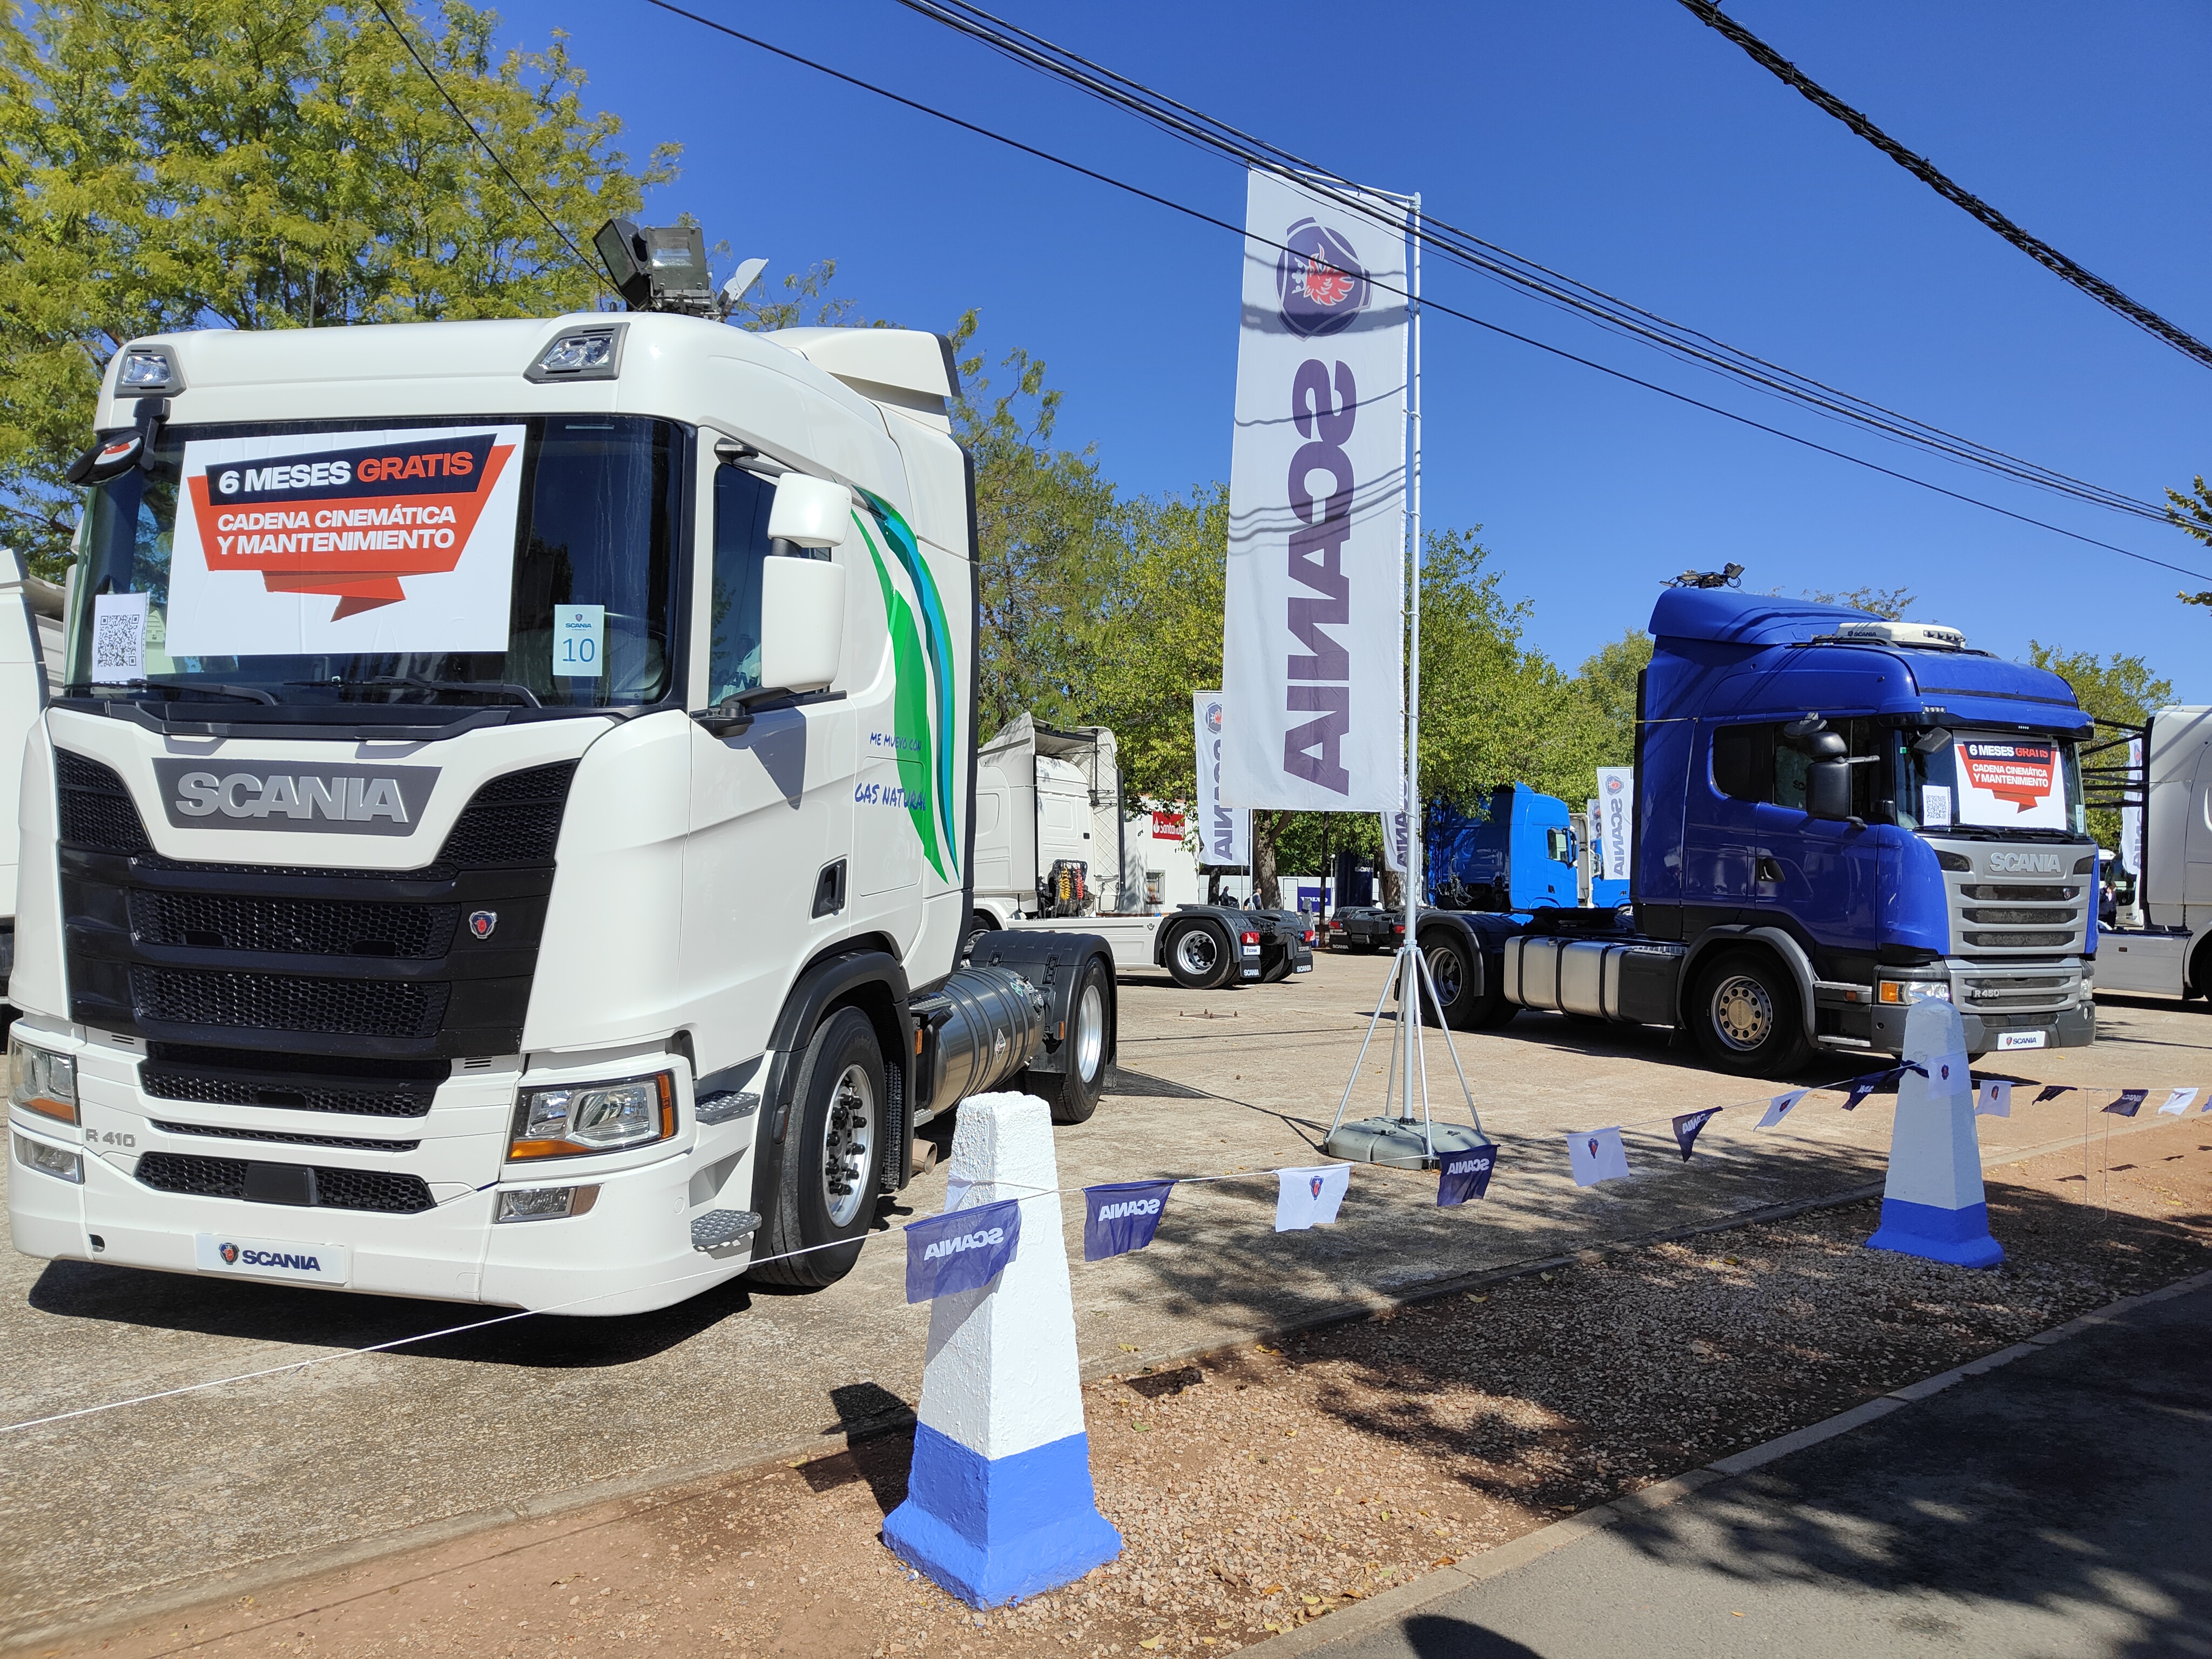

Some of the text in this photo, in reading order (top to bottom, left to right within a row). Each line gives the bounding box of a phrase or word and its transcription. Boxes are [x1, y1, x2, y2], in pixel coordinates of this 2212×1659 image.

[219, 451, 473, 494] 6 MESES GRATIS
[218, 504, 456, 531] CADENA CINEMÁTICA
[217, 528, 455, 555] Y MANTENIMIENTO
[563, 638, 595, 662] 10
[869, 731, 922, 751] ME MUEVO CON
[1969, 745, 2048, 758] 6 MESES GRATIS
[1972, 764, 2048, 778] CADENA CINEMÁTICA
[1973, 773, 2048, 787] Y MANTENIMIENTO
[176, 772, 409, 823] SCANIA
[854, 782, 926, 811] GAS NATURAL
[1160, 821, 1185, 835] Santander
[1990, 852, 2061, 873] SCANIA
[1974, 989, 2000, 998] R 450
[85, 1128, 136, 1148] R 410
[242, 1249, 322, 1272] SCANIA
